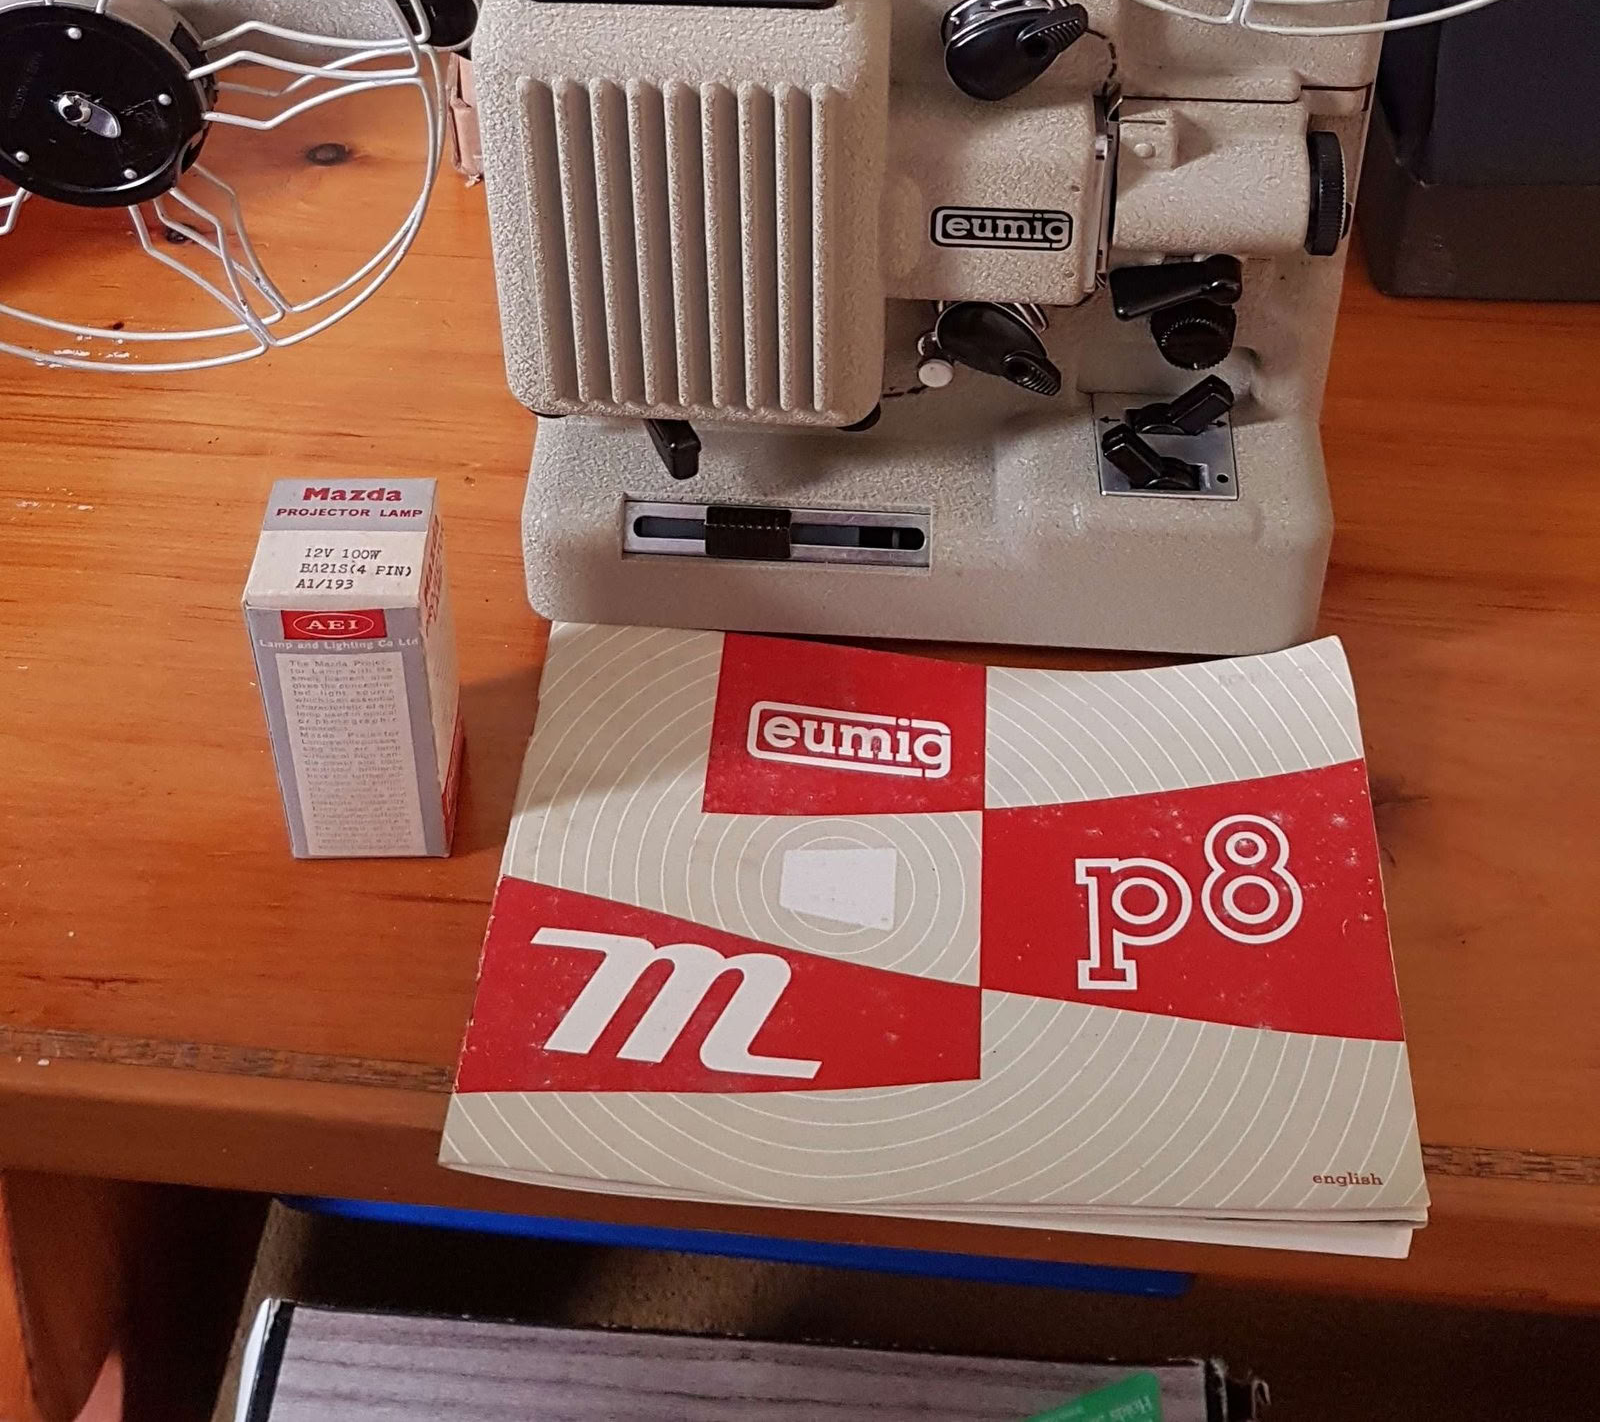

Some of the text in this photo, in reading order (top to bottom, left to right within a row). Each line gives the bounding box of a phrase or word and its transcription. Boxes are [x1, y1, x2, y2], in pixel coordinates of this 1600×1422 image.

[945, 212, 1070, 249] eumig
[302, 487, 402, 502] Mazda
[276, 508, 423, 518] PROJECTOR LAMP
[304, 547, 381, 560] 12V 100W
[305, 619, 360, 630] AEI
[259, 639, 293, 650] Lamp
[297, 638, 319, 649] and
[323, 638, 374, 651] Lighting
[762, 716, 951, 779] eumig
[1074, 814, 1304, 991] p8
[530, 927, 822, 1080] m
[1312, 1172, 1384, 1187] english
